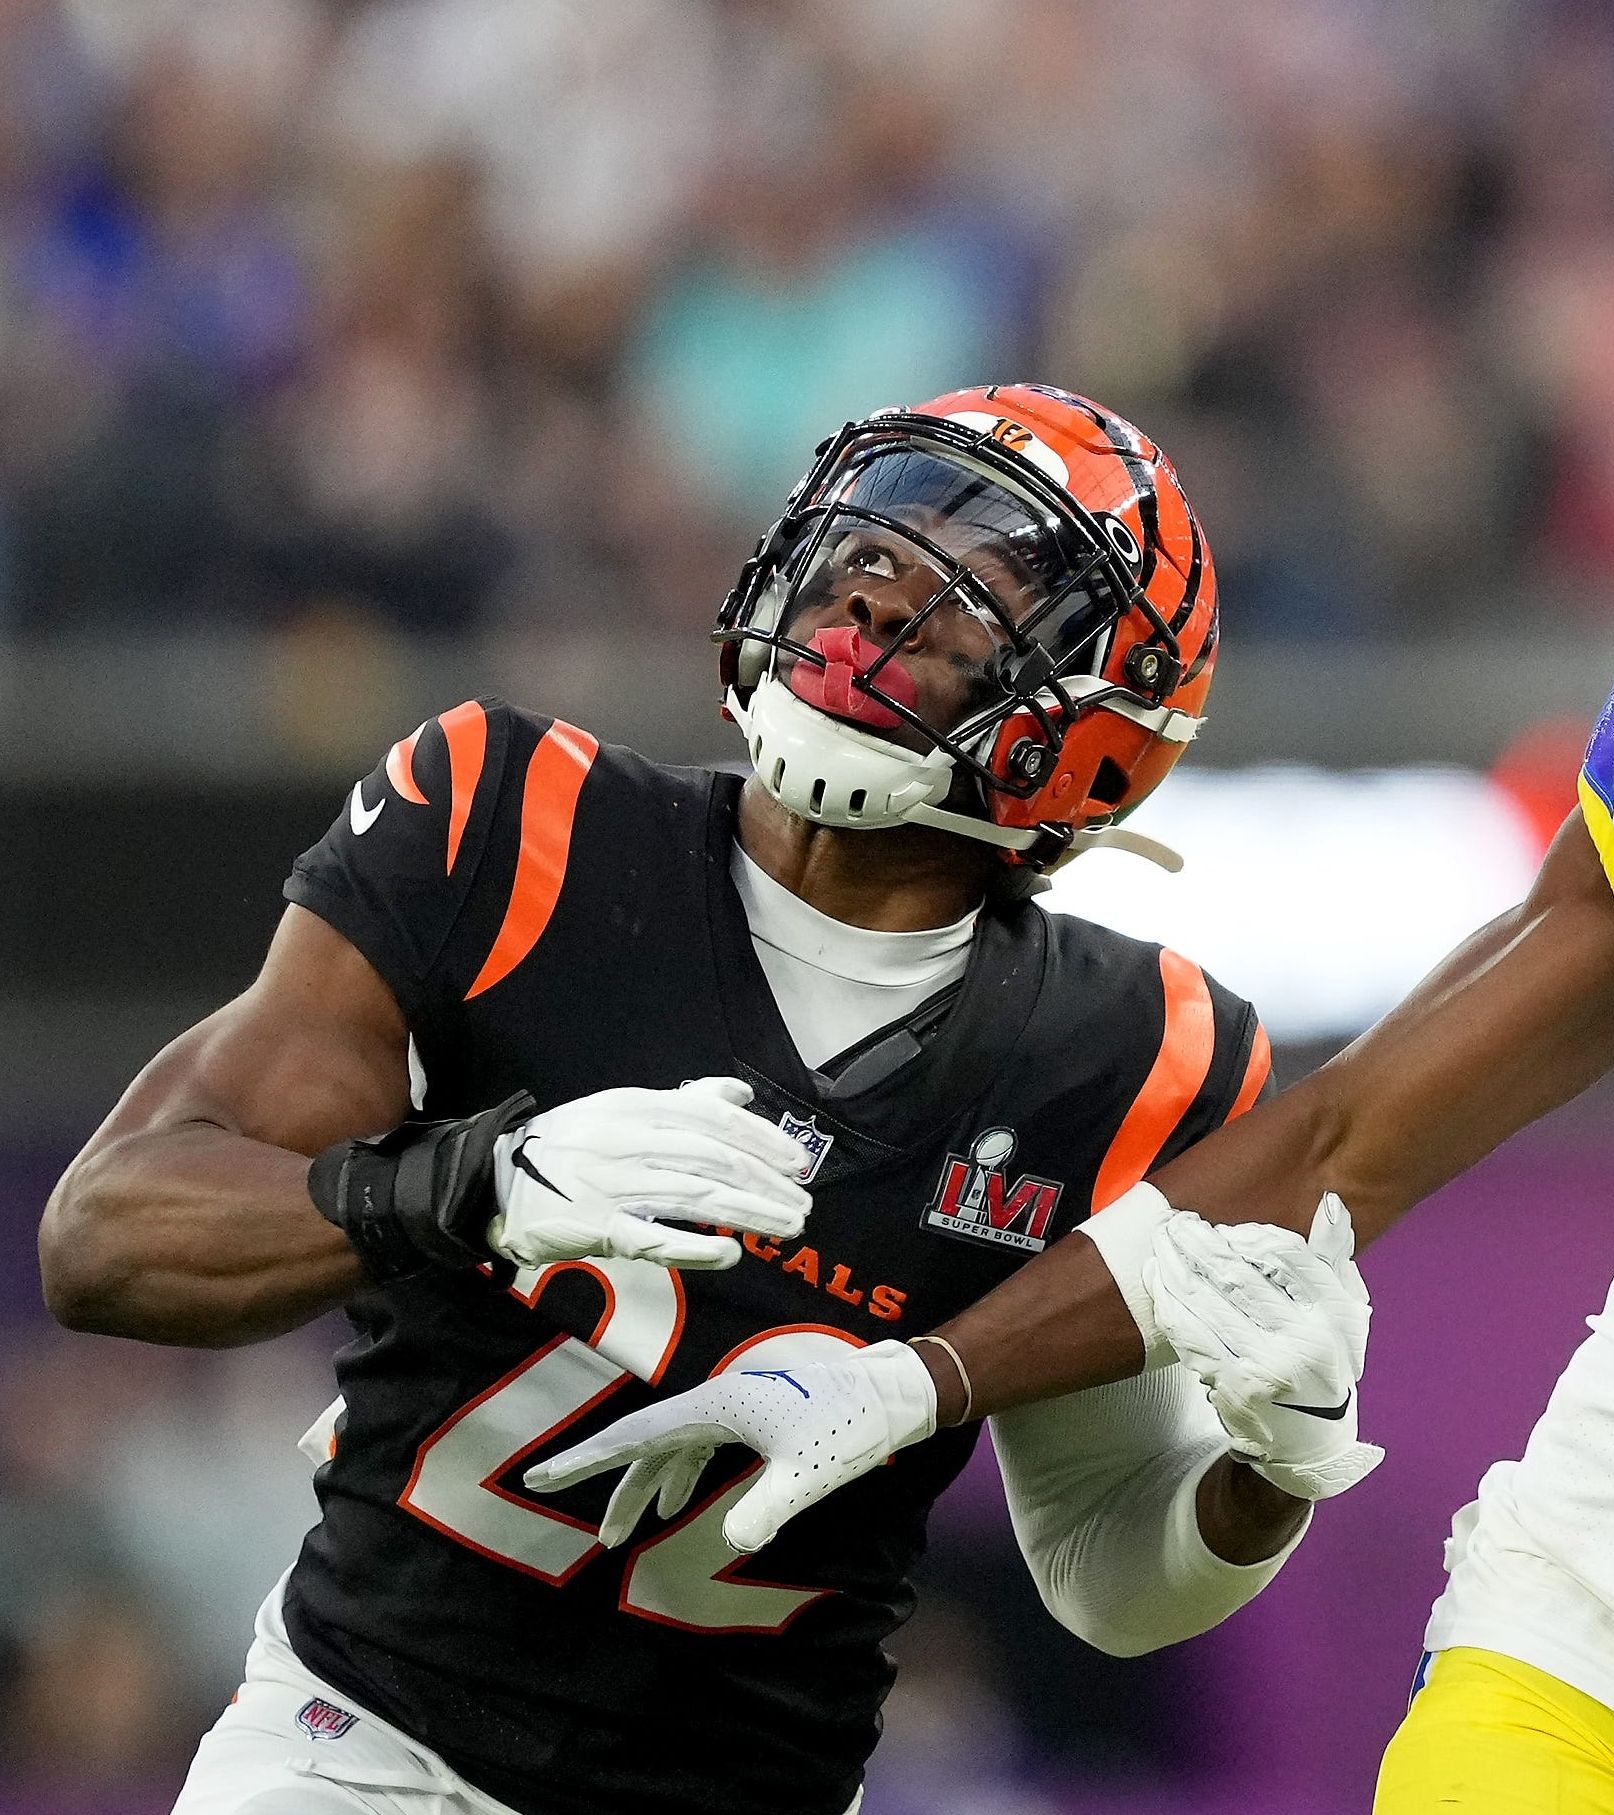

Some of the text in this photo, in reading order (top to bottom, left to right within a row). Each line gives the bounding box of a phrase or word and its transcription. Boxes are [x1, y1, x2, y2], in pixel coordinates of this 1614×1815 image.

[941, 1216, 1032, 1248] SUPER BOWL
[302, 1705, 343, 1731] NFL
